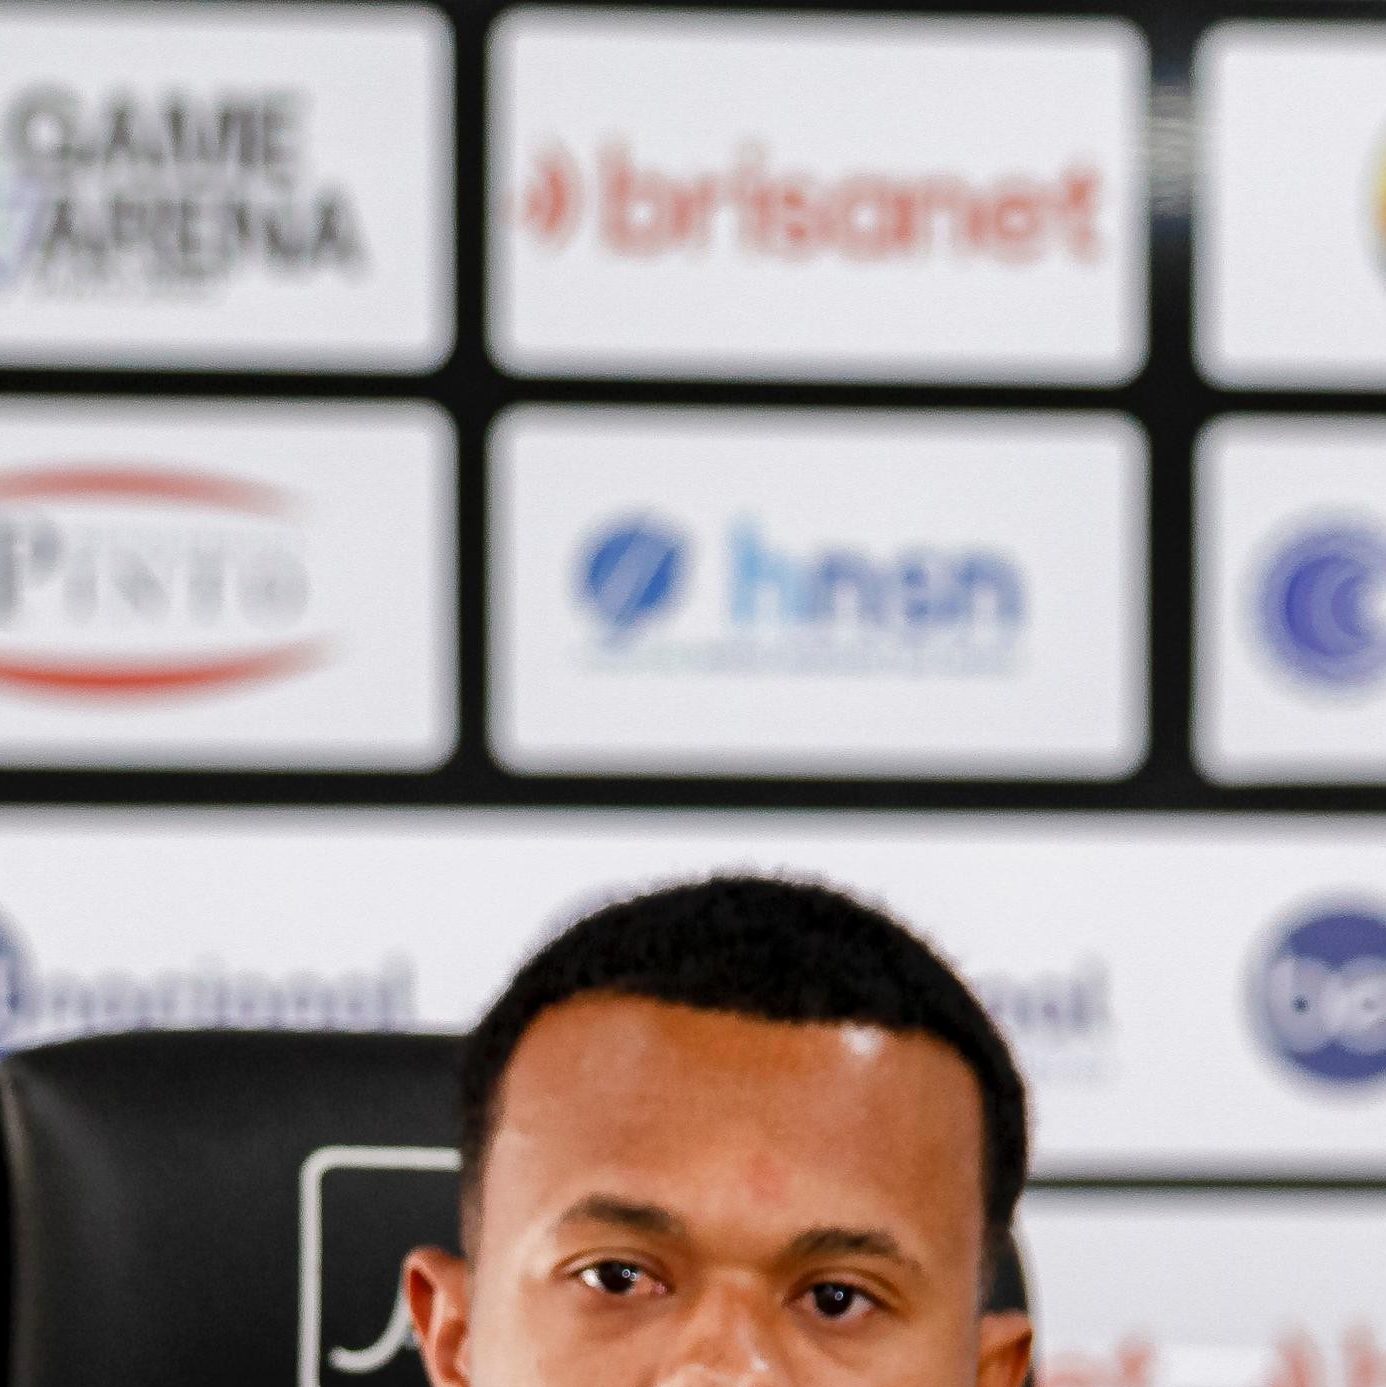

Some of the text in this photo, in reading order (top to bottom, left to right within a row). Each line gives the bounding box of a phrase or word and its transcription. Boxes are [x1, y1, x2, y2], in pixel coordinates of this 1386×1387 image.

[6, 83, 306, 172] GAME
[41, 185, 366, 284] ARENA
[597, 132, 1103, 266] brisanet
[726, 510, 1029, 637] hnsn
